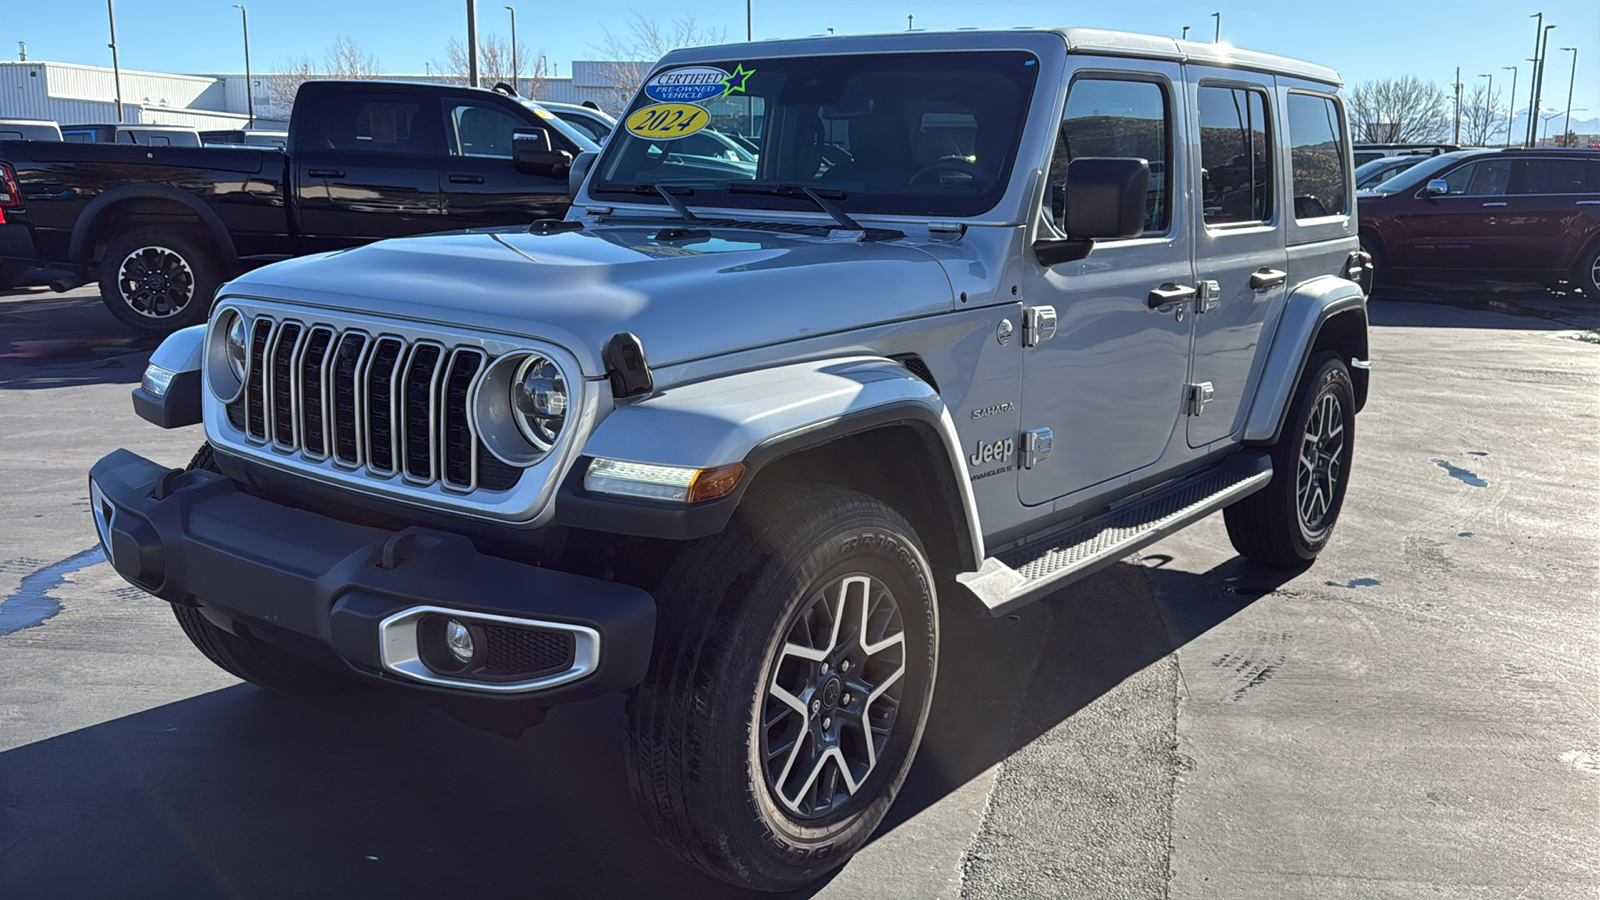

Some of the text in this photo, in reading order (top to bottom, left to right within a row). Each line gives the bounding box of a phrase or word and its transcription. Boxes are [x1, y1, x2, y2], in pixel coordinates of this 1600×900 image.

[657, 73, 724, 84] CERTIFIED
[633, 110, 702, 131] 2024
[971, 402, 1015, 420] SAHARA
[970, 438, 1014, 466] Jeep
